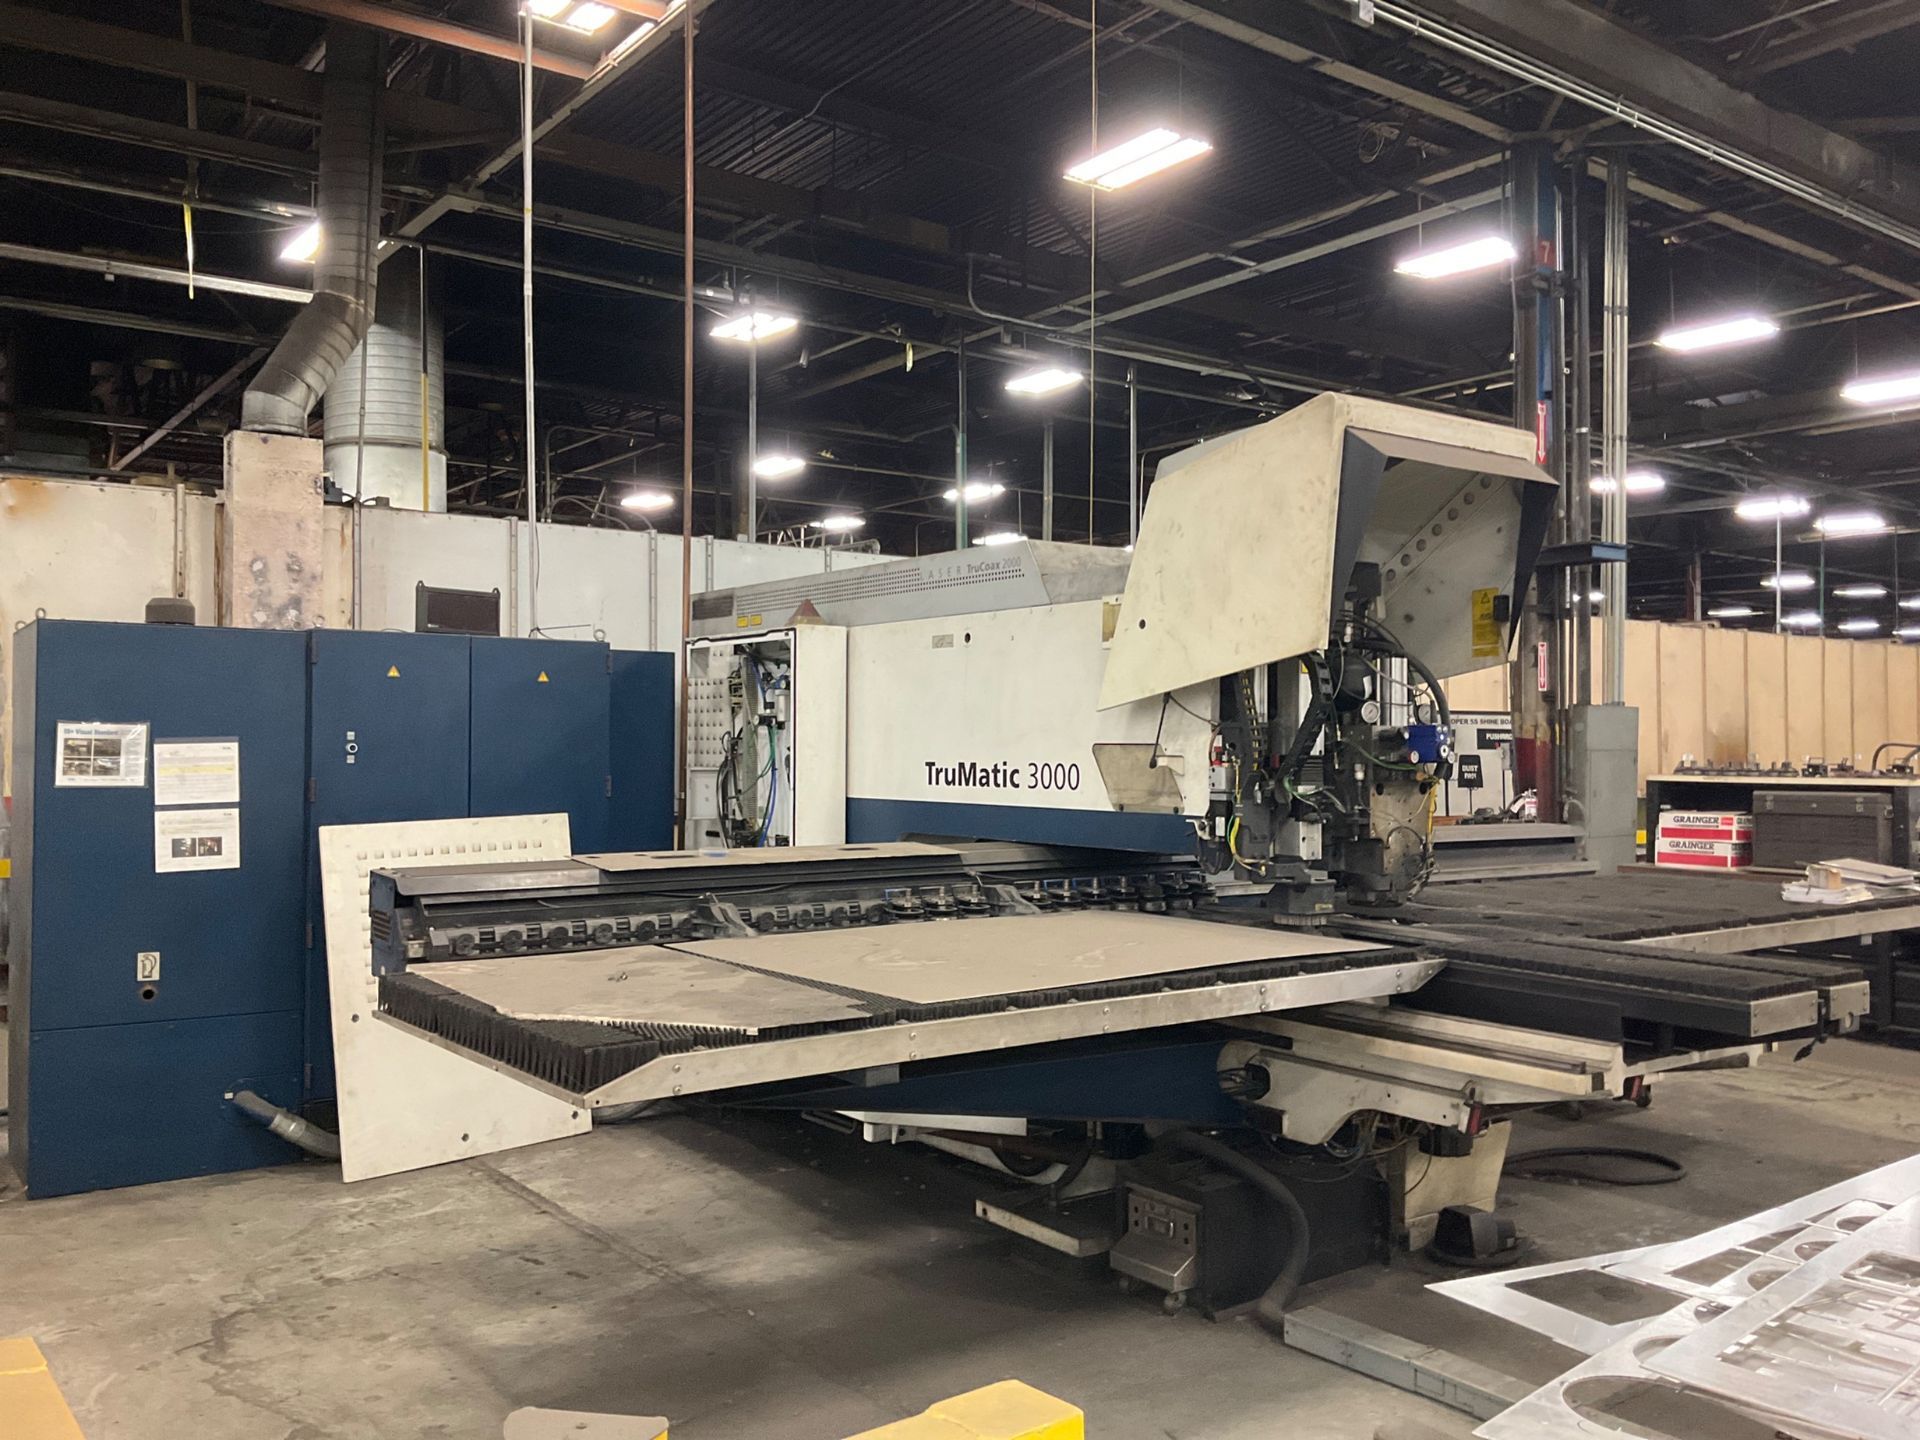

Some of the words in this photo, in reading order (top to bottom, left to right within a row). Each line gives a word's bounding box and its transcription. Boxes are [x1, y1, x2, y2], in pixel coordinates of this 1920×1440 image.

[920, 566, 961, 581] LASER
[967, 561, 1001, 574] TruCoax
[925, 761, 1020, 789] TruMatic
[1027, 763, 1080, 791] 3000
[1673, 815, 1719, 824] GRAINGER
[1669, 840, 1714, 850] GRAINGER
